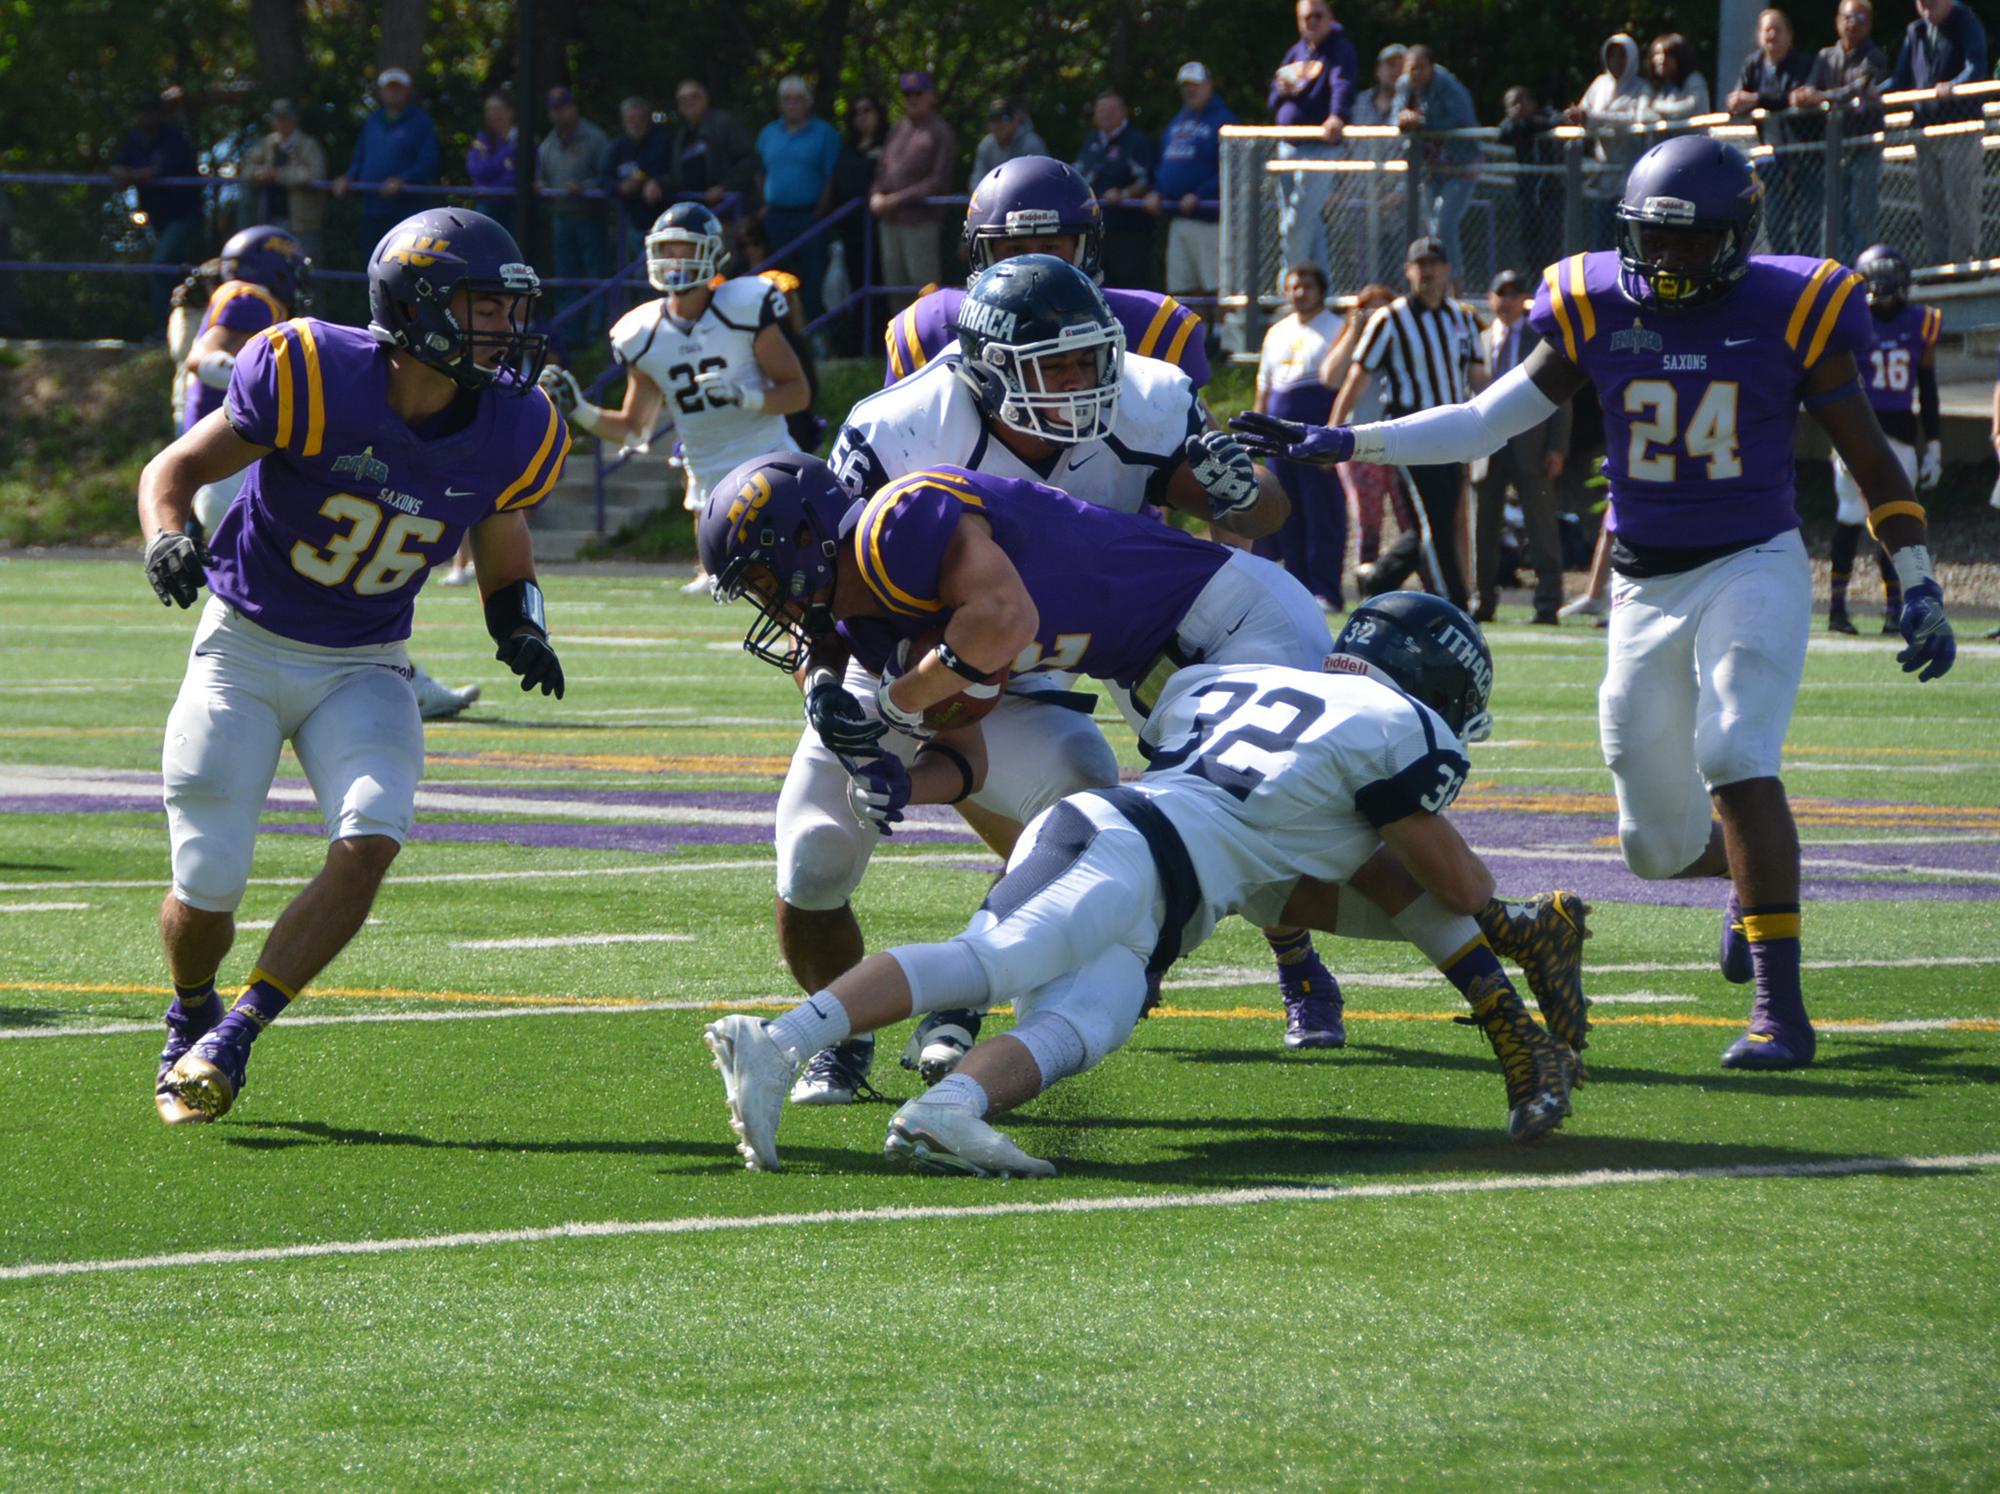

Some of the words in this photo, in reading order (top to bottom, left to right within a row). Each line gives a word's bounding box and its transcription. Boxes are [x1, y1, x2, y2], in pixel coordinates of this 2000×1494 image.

[959, 299, 1017, 342] ITHACA
[1663, 354, 1708, 371] SAXONS
[1870, 350, 1910, 391] 16
[1623, 379, 1744, 482] 24
[827, 430, 870, 499] 56
[377, 487, 424, 516] SAXONS
[290, 493, 446, 596] 36
[1344, 618, 1377, 646] 32
[1324, 656, 1369, 676] Riddell
[1138, 681, 1326, 802] 32
